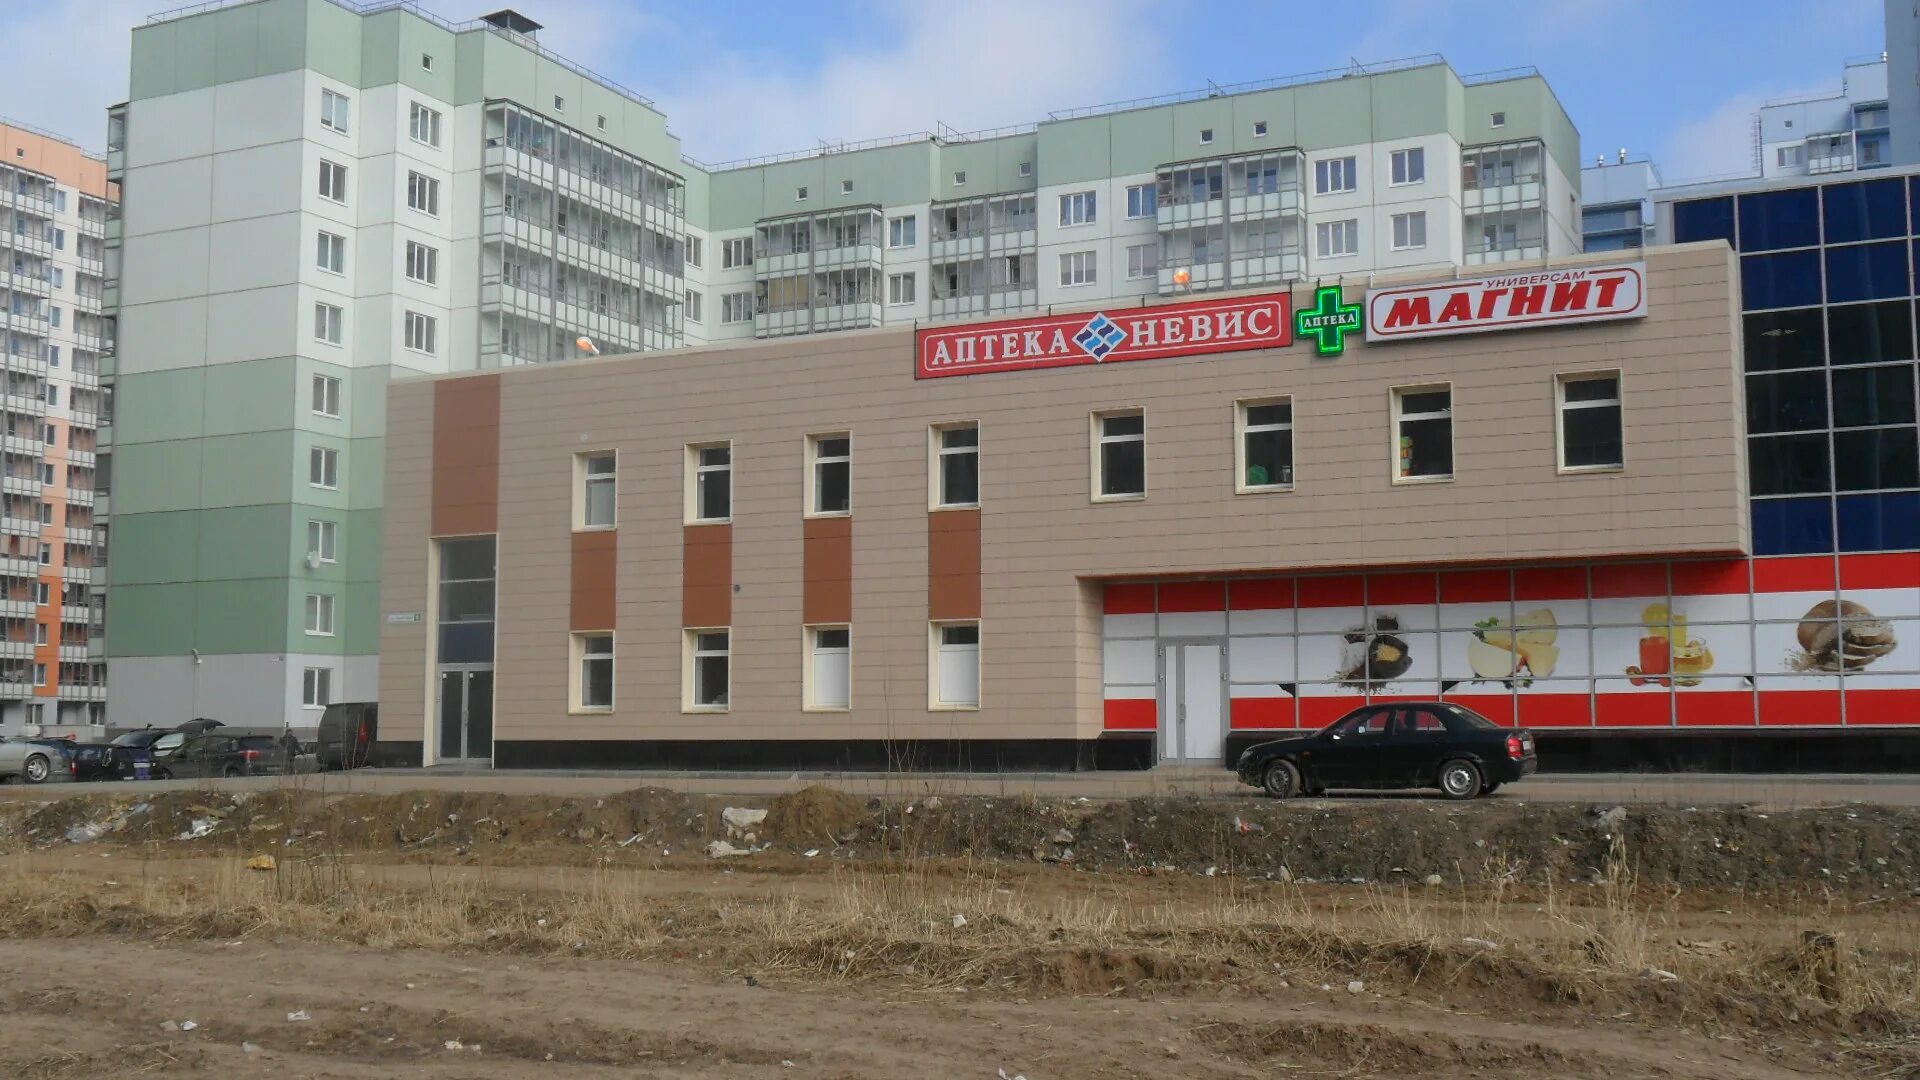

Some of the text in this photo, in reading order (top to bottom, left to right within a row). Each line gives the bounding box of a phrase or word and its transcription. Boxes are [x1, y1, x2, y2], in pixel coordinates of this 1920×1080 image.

[1486, 270, 1586, 289] УНИВЕРСАМ
[1384, 276, 1626, 328] МАГНИТ
[932, 308, 1273, 365] АПТЕКА НЕВИС
[1304, 312, 1356, 328] АПТЕКА
